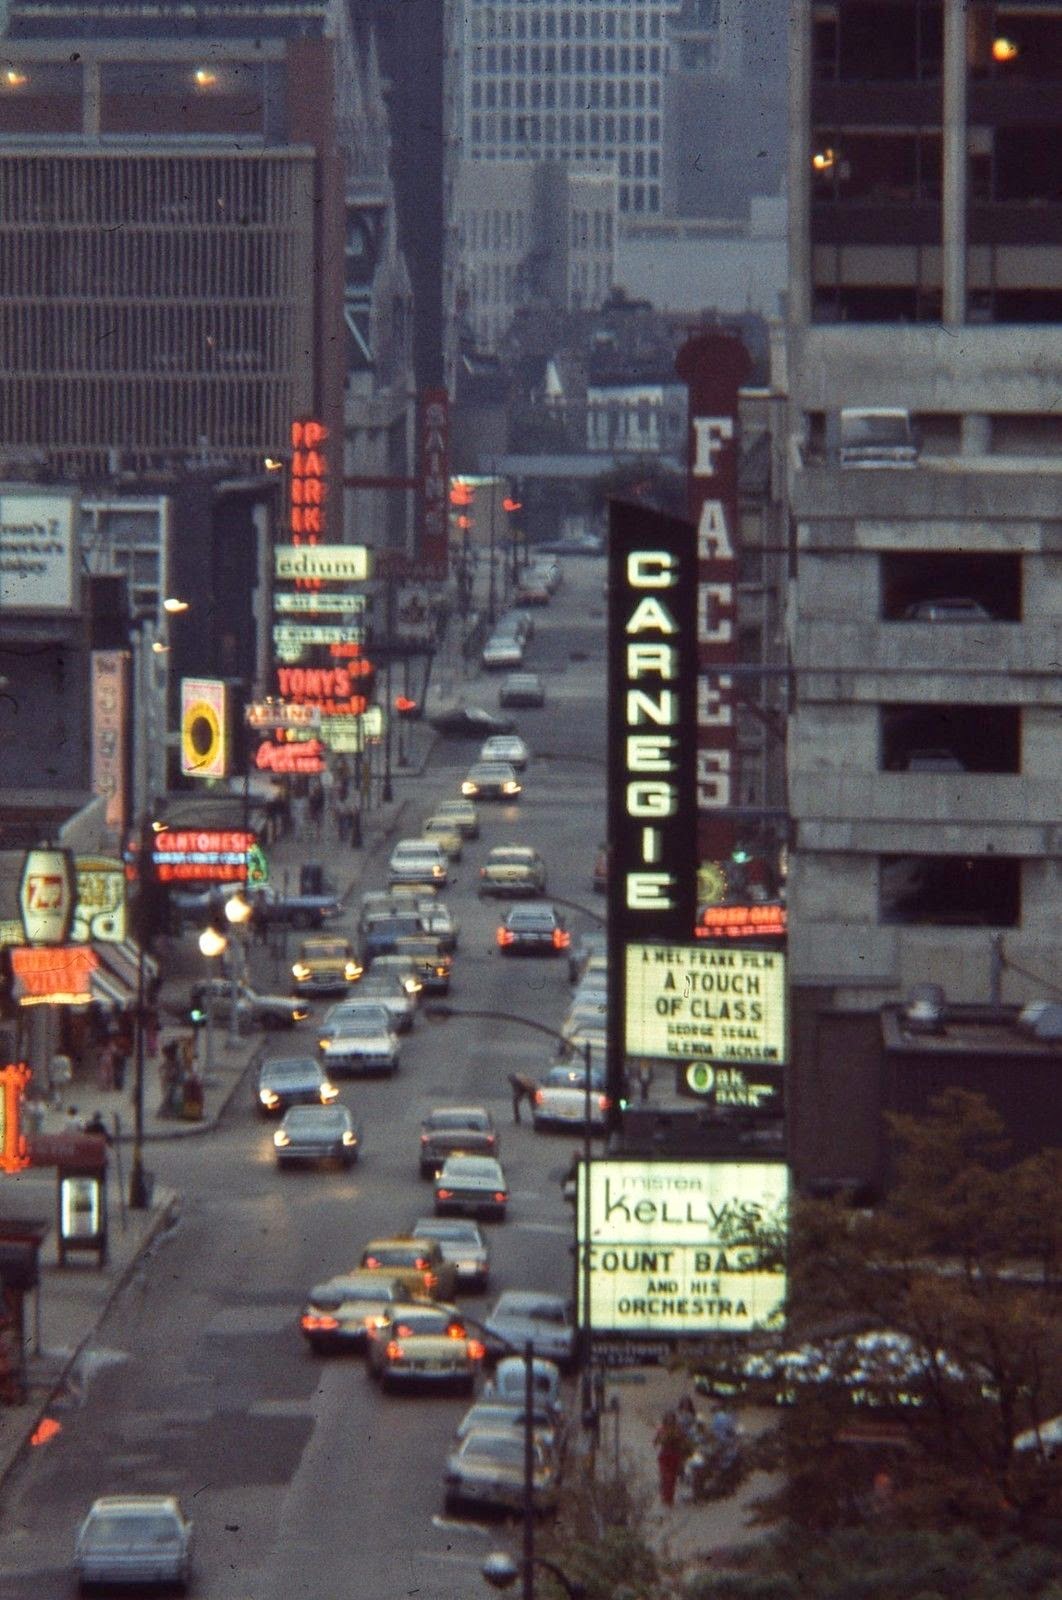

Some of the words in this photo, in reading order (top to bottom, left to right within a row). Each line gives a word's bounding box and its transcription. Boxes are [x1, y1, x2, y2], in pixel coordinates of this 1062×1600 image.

[693, 416, 735, 810] FACES
[625, 550, 679, 910] CARNEGIE
[664, 972, 676, 990] A
[689, 972, 760, 994] TOUCH
[656, 998, 682, 1016] OF
[690, 1000, 762, 1021] CLASS
[647, 1280, 679, 1294] AND
[691, 1280, 720, 1293] HIS
[618, 1299, 748, 1316] ORCHESTRA
